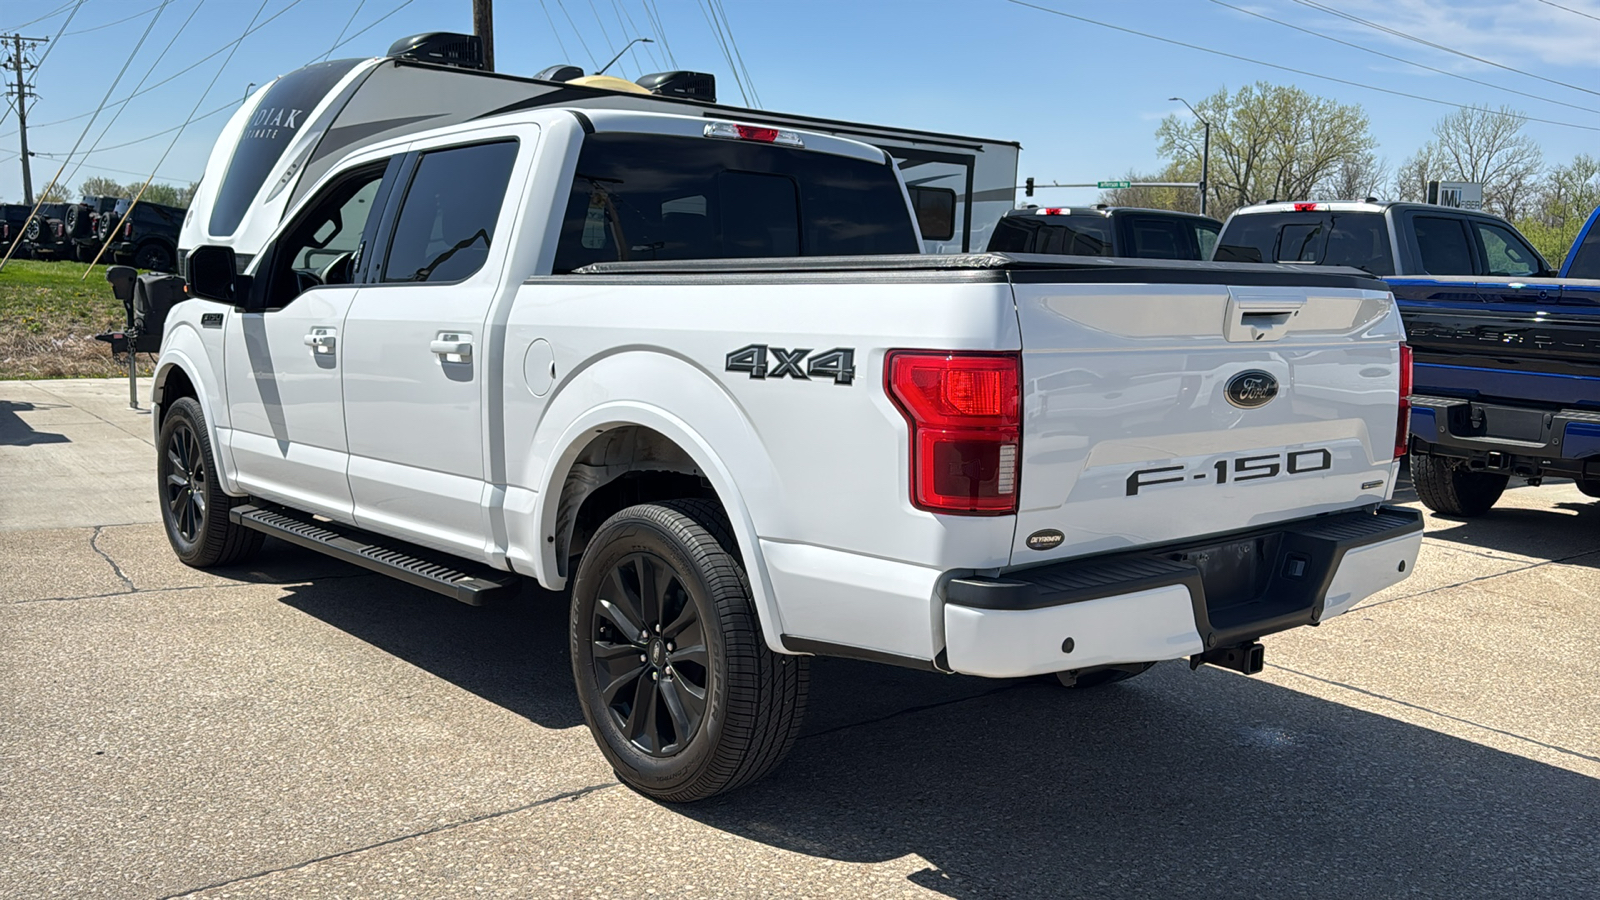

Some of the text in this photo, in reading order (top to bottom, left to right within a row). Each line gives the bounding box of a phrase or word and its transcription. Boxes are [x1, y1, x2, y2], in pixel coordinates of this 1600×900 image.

[1441, 189, 1462, 208] IMU
[1239, 377, 1269, 400] Ford
[1126, 448, 1332, 497] F-150
